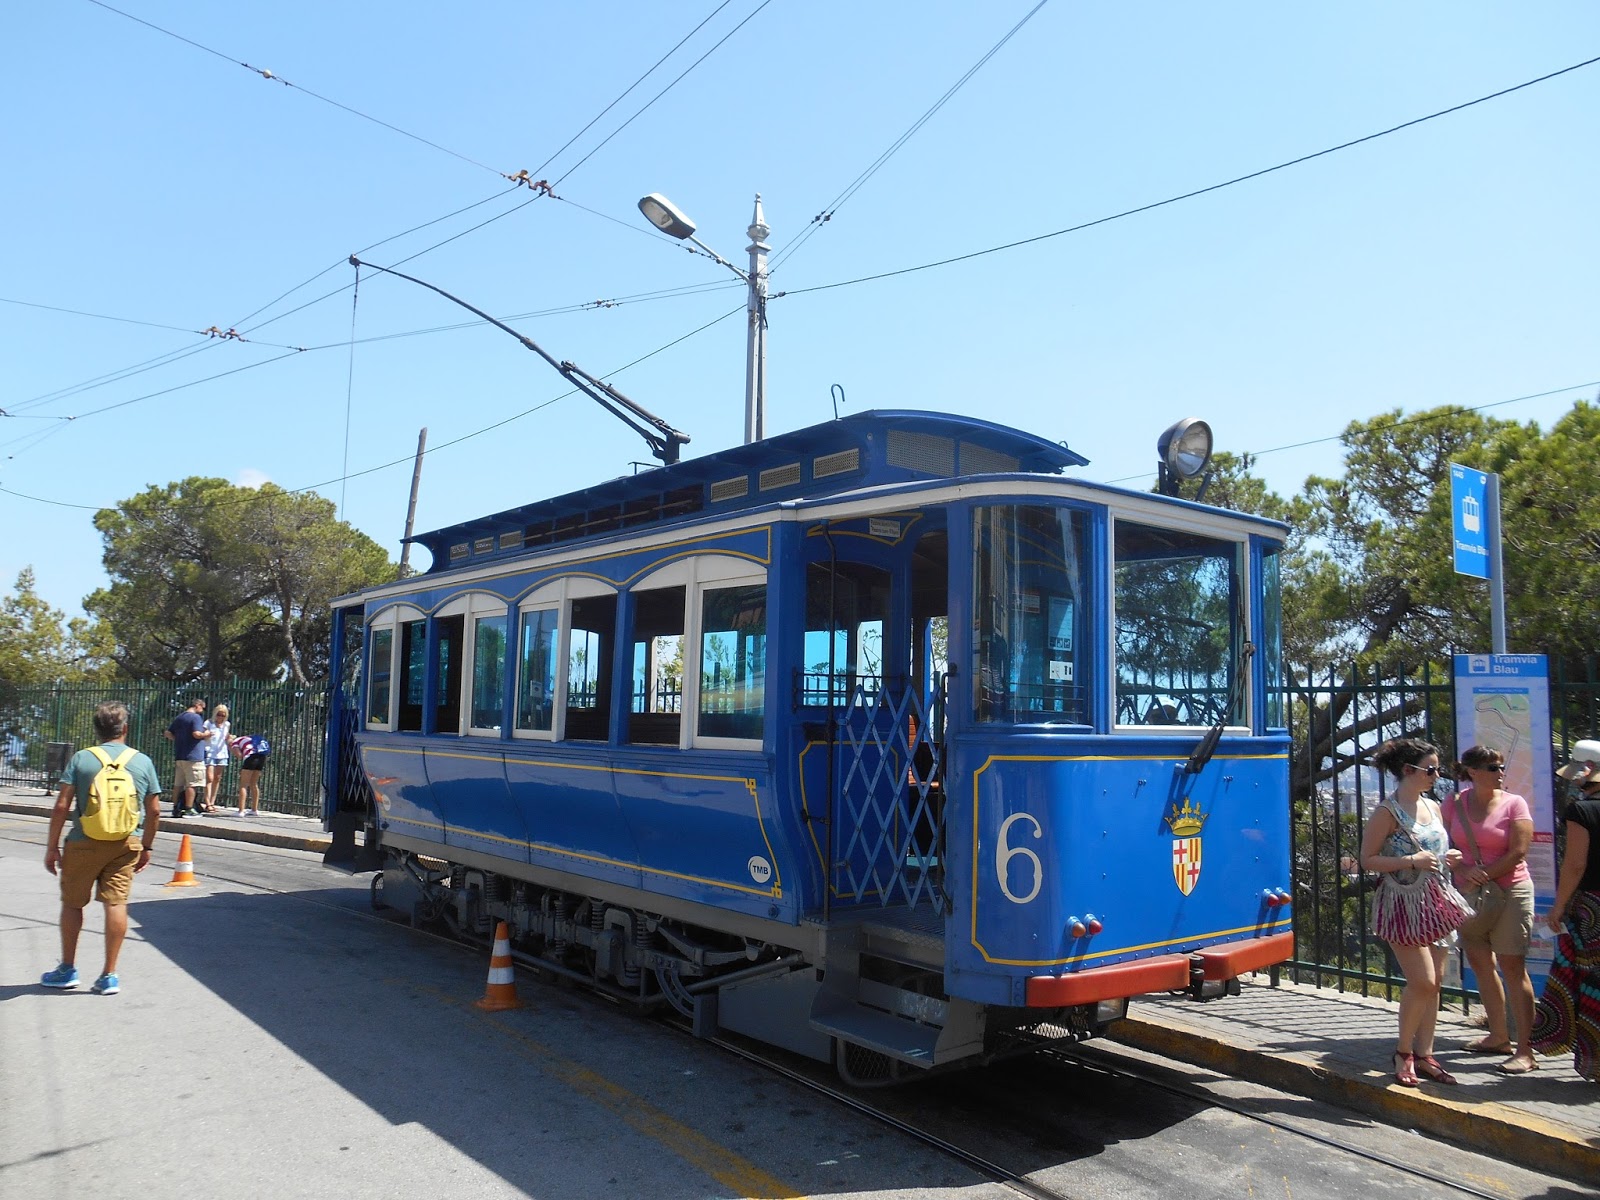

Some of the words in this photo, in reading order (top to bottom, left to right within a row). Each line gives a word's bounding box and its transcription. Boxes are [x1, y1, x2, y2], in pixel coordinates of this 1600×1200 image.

[1455, 540, 1477, 554] Tramvia
[1493, 655, 1537, 664] Tramvia
[1493, 665, 1519, 674] Blau
[995, 812, 1043, 904] 6
[752, 865, 768, 875] TMB
